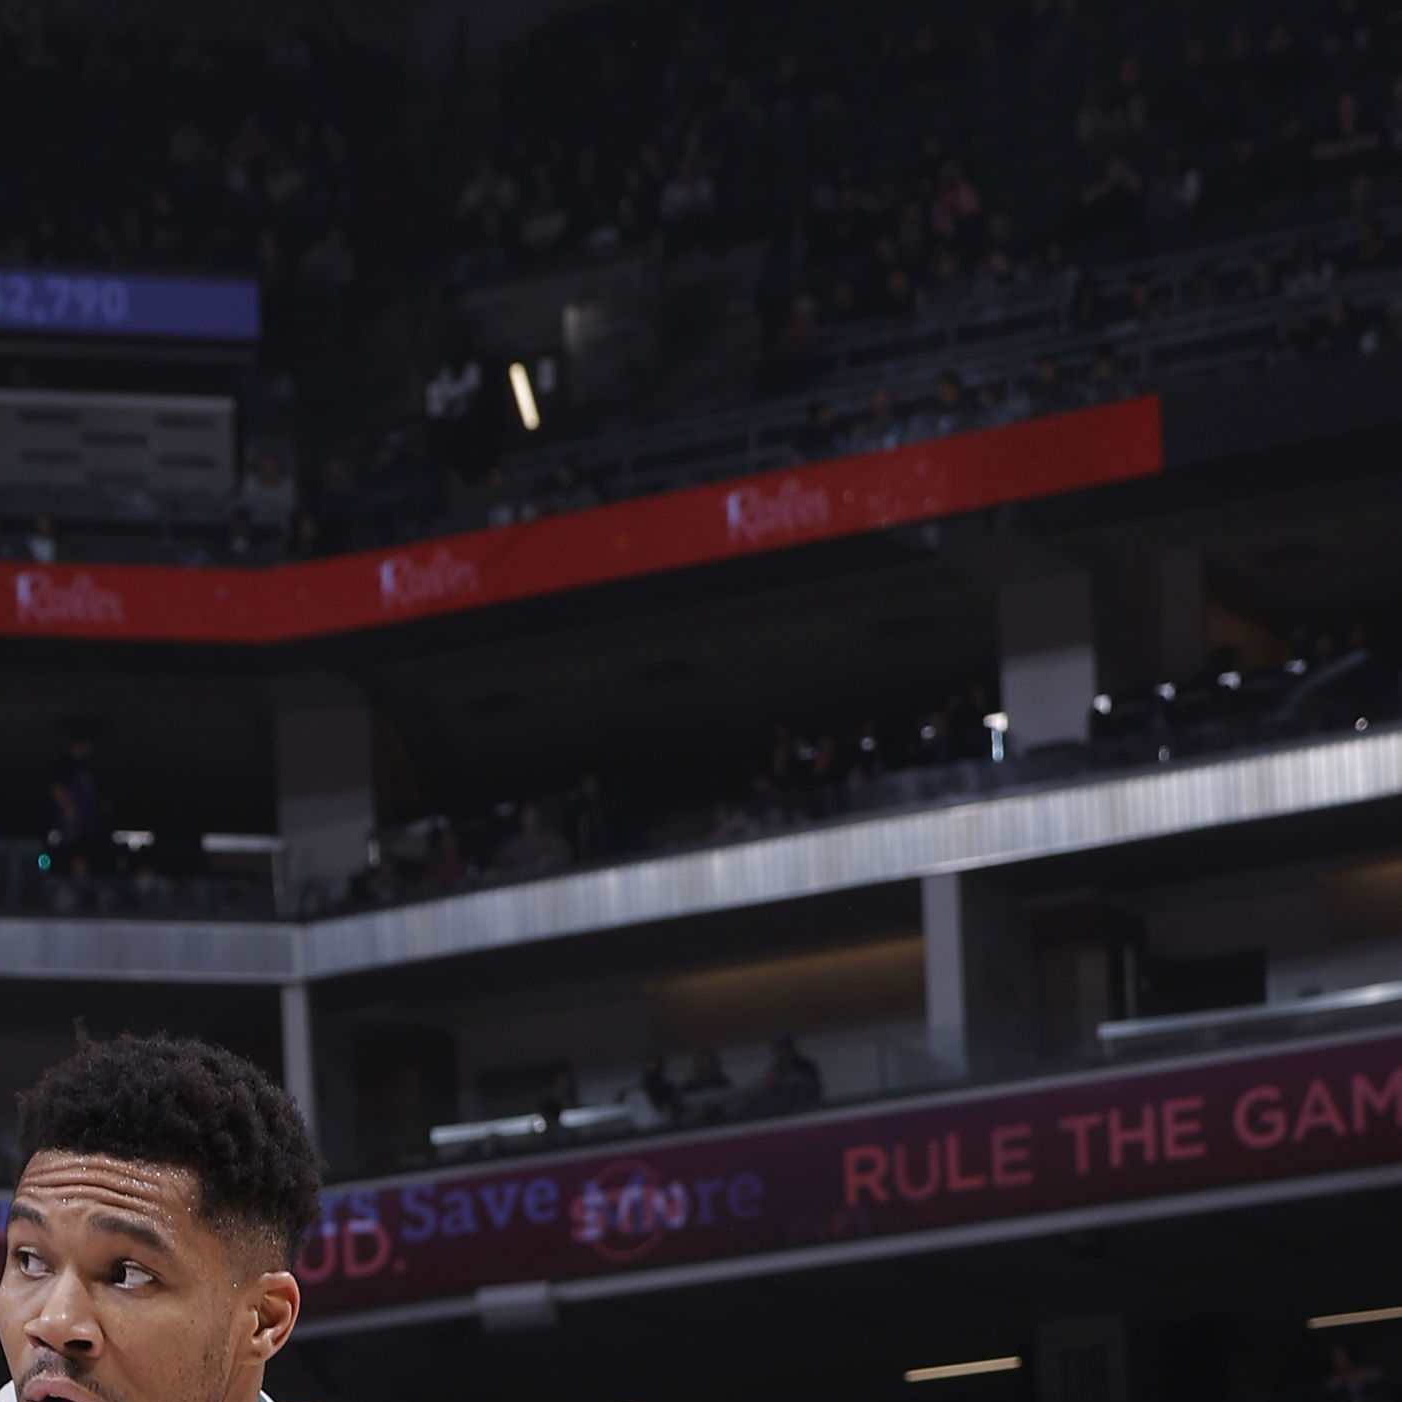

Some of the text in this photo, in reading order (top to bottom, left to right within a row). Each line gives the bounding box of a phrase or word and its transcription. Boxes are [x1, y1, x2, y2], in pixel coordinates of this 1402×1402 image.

[842, 1122, 1034, 1207] RULE
[1060, 1096, 1207, 1178] THE
[400, 1175, 561, 1243] Save
